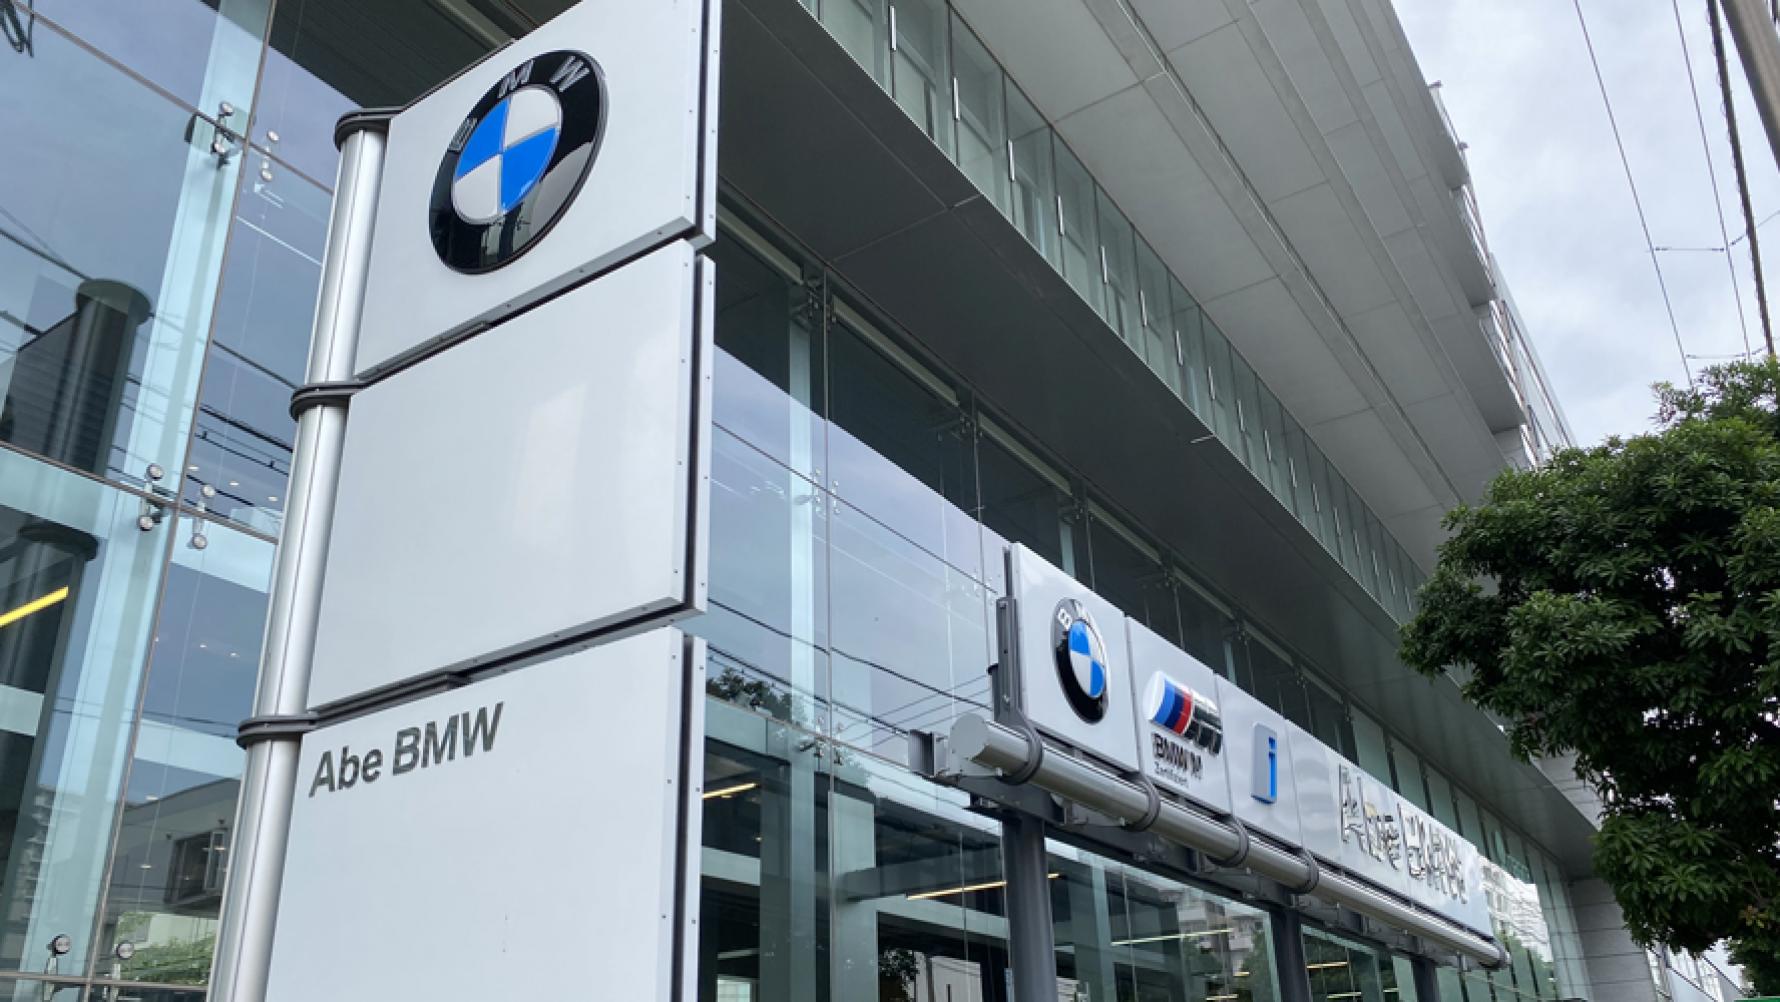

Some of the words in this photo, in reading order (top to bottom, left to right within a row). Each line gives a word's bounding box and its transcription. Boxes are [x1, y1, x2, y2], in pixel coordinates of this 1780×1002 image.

[447, 55, 591, 152] BMW
[308, 745, 383, 798] Abe
[392, 701, 504, 777] BMW
[1152, 732, 1188, 772] BMW
